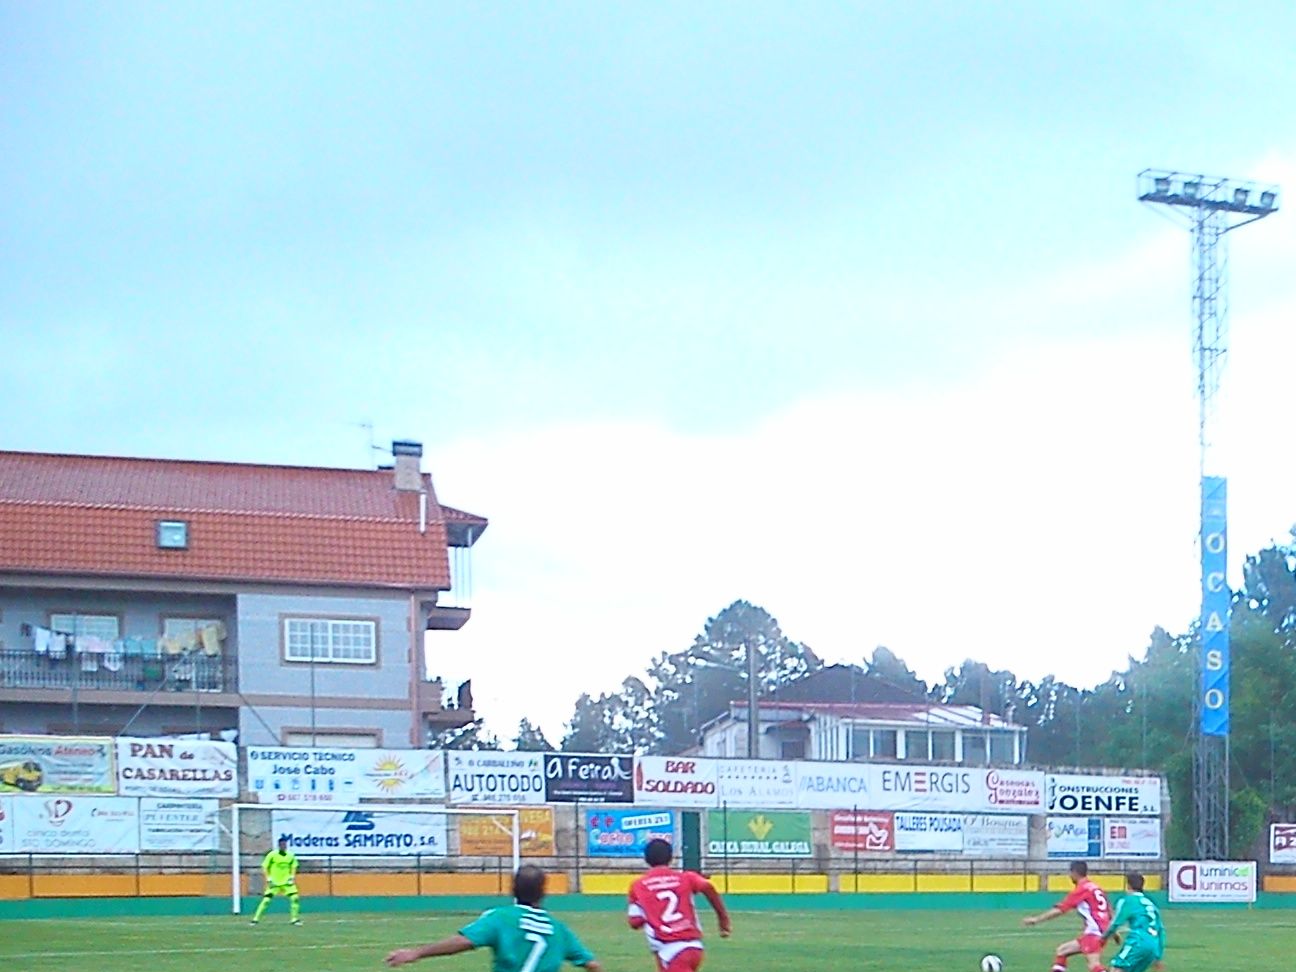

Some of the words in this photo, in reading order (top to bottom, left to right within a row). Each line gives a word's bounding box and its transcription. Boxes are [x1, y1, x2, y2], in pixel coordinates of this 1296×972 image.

[130, 743, 173, 759] PAN
[179, 750, 195, 760] de
[260, 751, 309, 761] SERVICIO
[122, 767, 233, 782] CASARELLAS
[304, 764, 336, 776] Cabo
[665, 760, 696, 774] BAR
[452, 773, 544, 793] AUTOTODO
[645, 779, 715, 795] SOLDADO
[882, 770, 971, 793] EMERGIS
[896, 815, 927, 832] TALLERES
[929, 816, 962, 832] POUSADA
[281, 832, 340, 847] Maderas
[656, 890, 684, 923] 2
